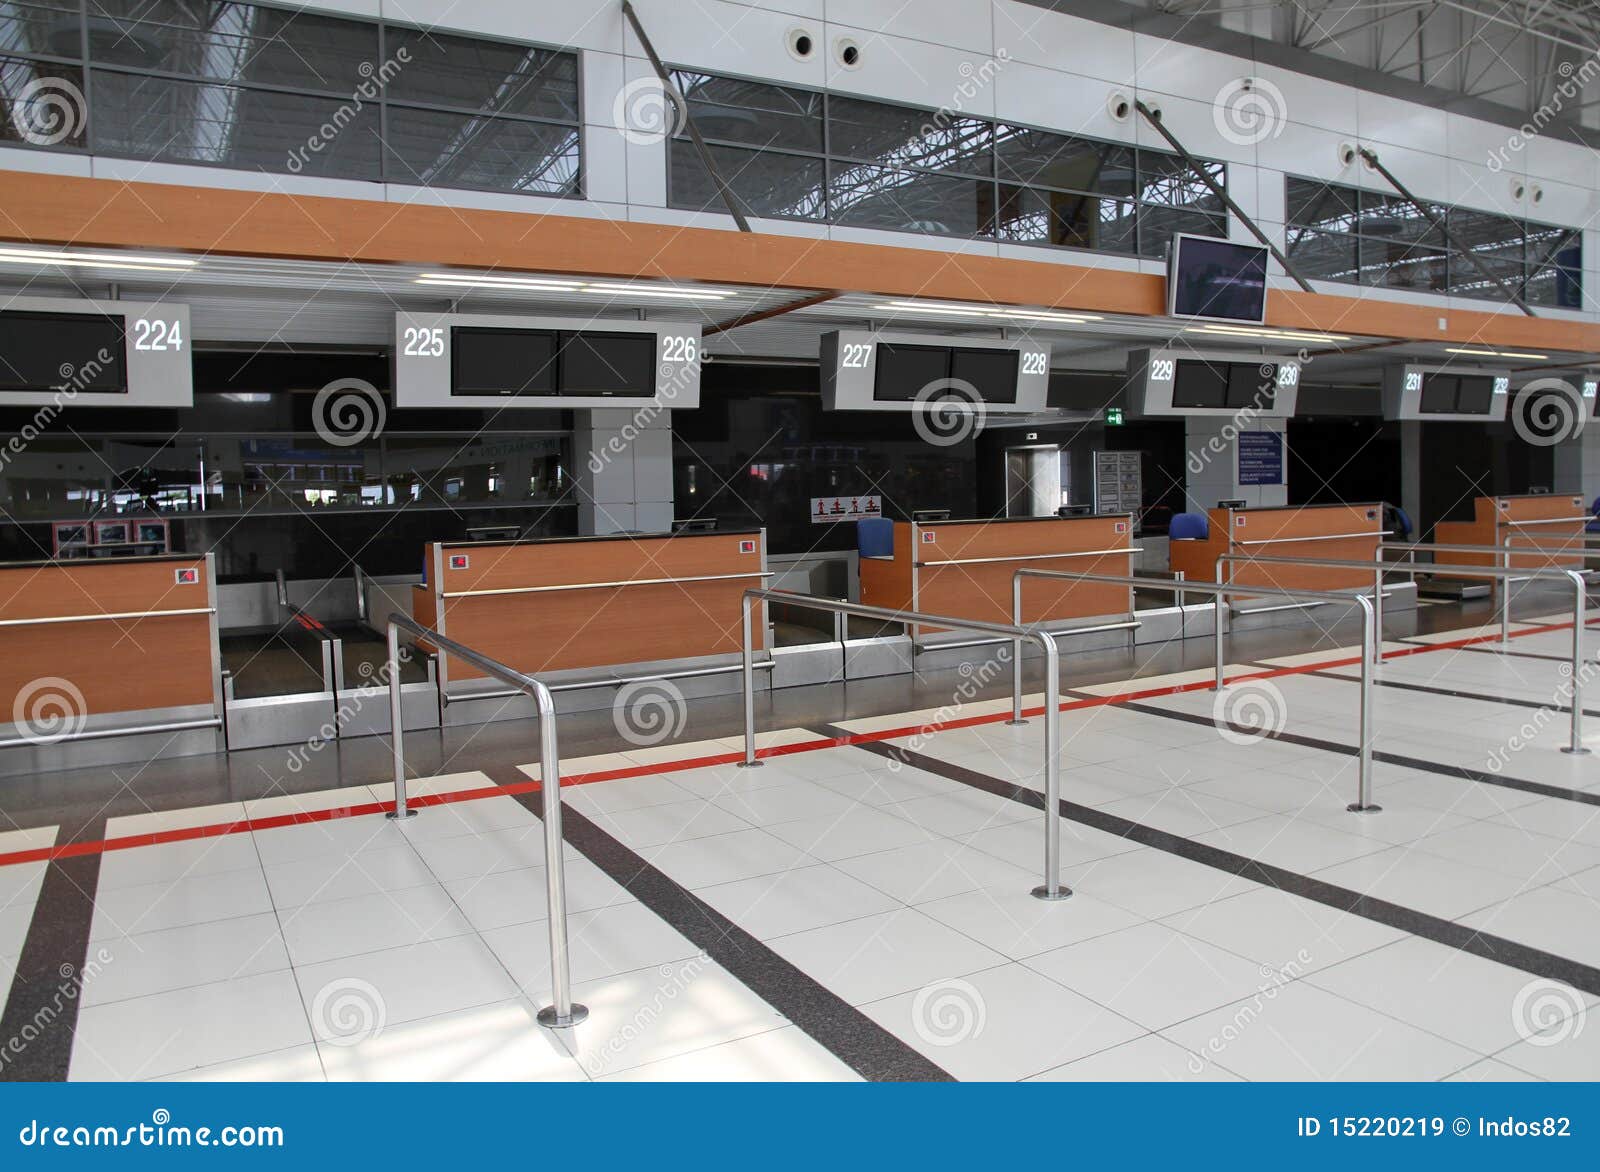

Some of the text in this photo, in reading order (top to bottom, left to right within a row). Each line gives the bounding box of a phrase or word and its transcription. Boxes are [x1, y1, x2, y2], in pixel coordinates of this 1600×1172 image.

[134, 319, 183, 351] 224
[404, 328, 444, 356] 225
[662, 336, 696, 363] 226
[843, 344, 872, 368] 227
[1022, 352, 1046, 375] 228
[1151, 360, 1173, 380] 229
[1279, 366, 1297, 386] 230
[1406, 373, 1421, 391] 231
